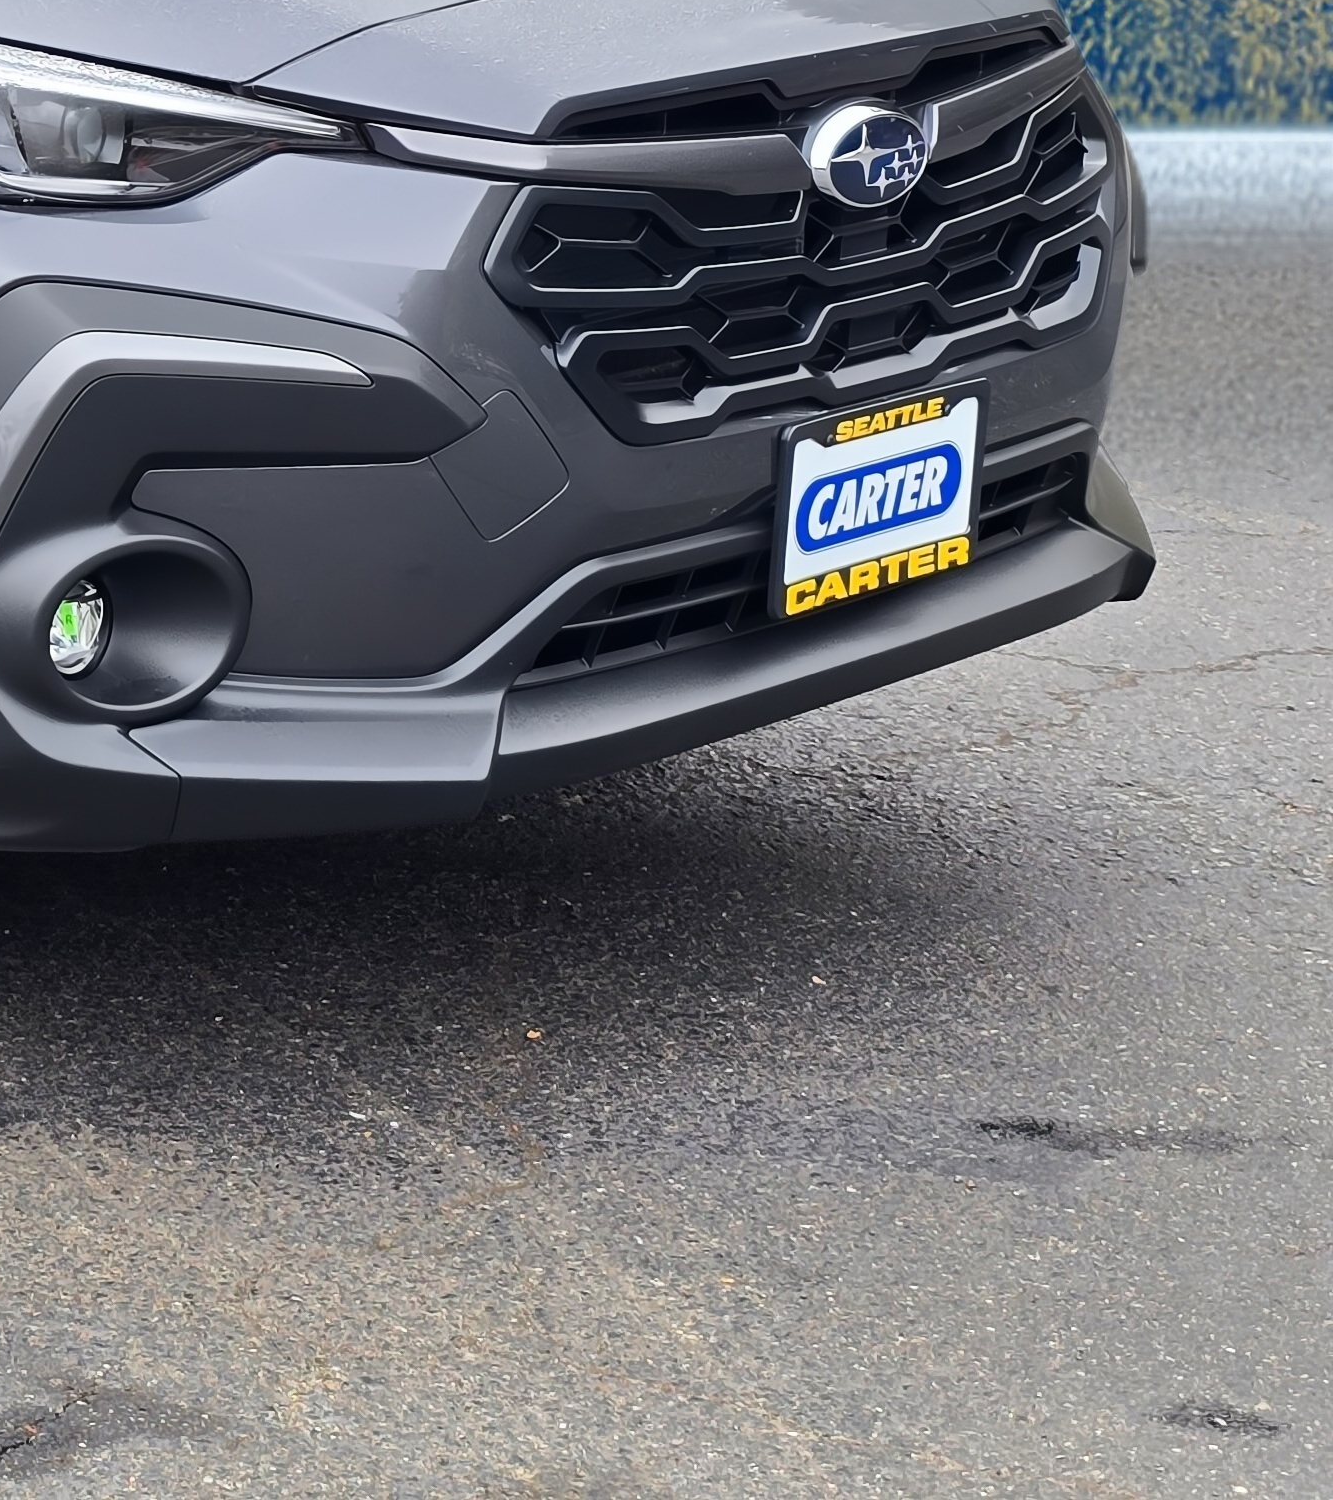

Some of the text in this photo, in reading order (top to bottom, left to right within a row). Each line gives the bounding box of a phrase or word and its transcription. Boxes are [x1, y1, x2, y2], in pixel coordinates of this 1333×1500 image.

[835, 396, 945, 443] SEATTLE
[807, 455, 949, 541] CARTER
[785, 536, 970, 616] CARTER
